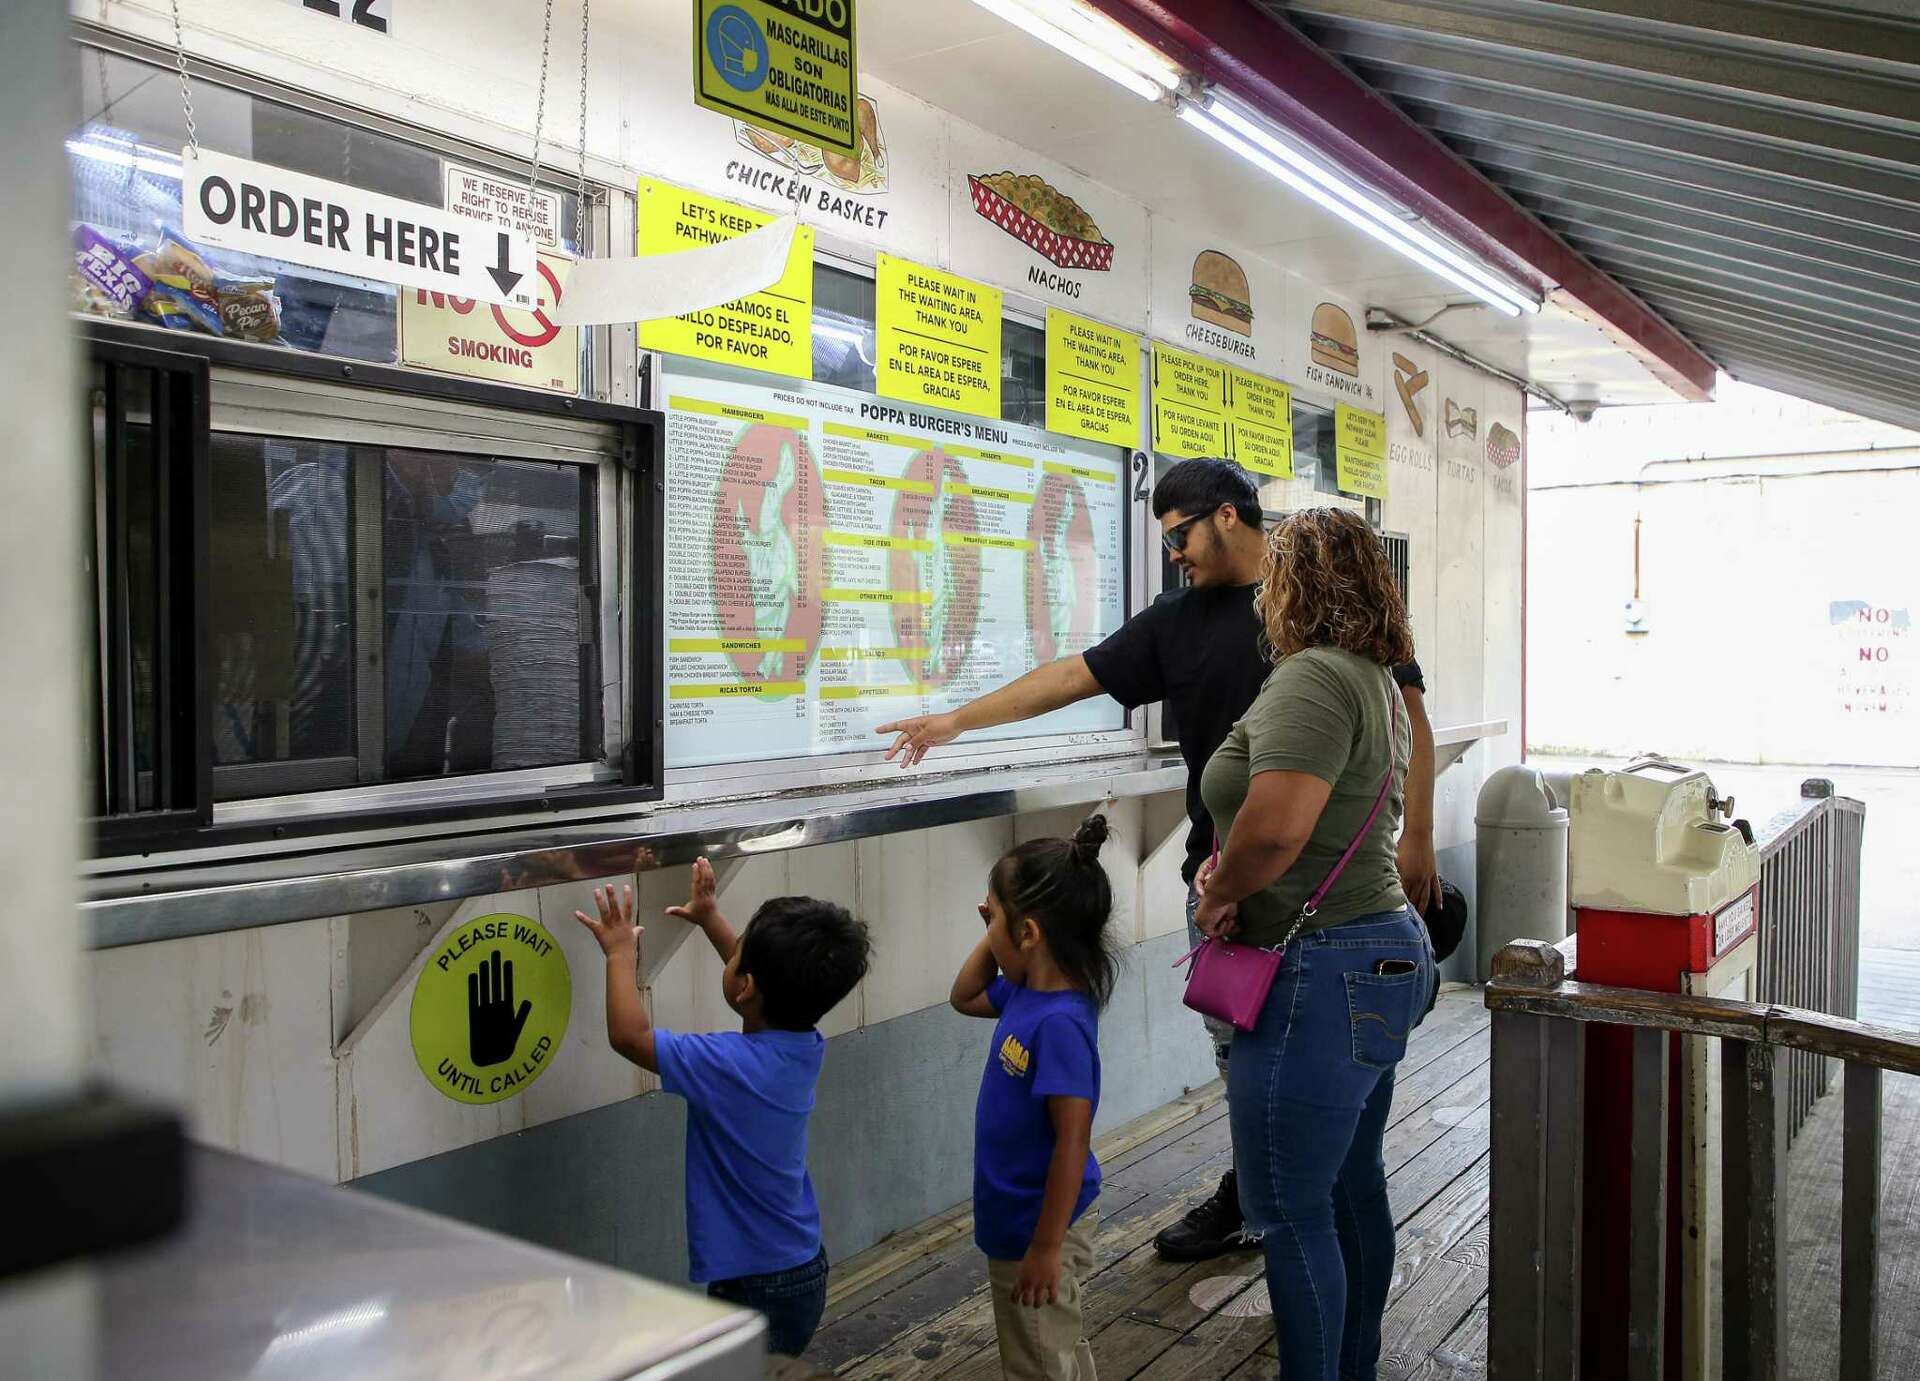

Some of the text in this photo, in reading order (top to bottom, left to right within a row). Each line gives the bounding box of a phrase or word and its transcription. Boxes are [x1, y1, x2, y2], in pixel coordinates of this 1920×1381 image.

[766, 18, 848, 69] MASCARILLAS
[794, 57, 823, 79] SON
[769, 67, 848, 112] OBLIGATORIAS
[800, 105, 808, 118] DE
[810, 108, 826, 125] ESTE
[828, 113, 849, 133] PUNTO
[463, 177, 548, 211] WE RESERVE THE
[726, 160, 888, 229] CHICKEN BASKET
[461, 192, 548, 225] RIGHT TO REFUSE
[682, 201, 752, 234] LET'S KEEP
[200, 175, 459, 276] ORDER HERE
[676, 221, 734, 245] PATHWA
[89, 243, 142, 292] BIG
[75, 251, 132, 312] TEXAS
[908, 274, 976, 303] PLEASE WAIT IN
[1028, 265, 1081, 298] NACHOS
[225, 302, 267, 318] Pecan
[776, 309, 790, 324] EL
[898, 288, 983, 324] THE WAITING AREA,
[236, 316, 260, 331] Pie
[718, 316, 795, 346] DESPEJADO,
[916, 310, 968, 334] THANK YOU
[696, 332, 768, 359] POR FAVOR
[1062, 337, 1076, 350] THE
[1077, 341, 1107, 359] WAITING
[1070, 325, 1121, 348] PLEASE WAIT IN
[1185, 324, 1256, 360] CHEESEBURGER
[448, 336, 533, 369] SMOKING
[899, 343, 982, 373] POR FAVOR ESPERE
[889, 358, 990, 392] EN EL AREA DE ESPERA,
[1076, 356, 1115, 376] THANK YOU
[1161, 353, 1219, 378] PLEASE PICK UP YOUR
[1174, 370, 1193, 385] ORDER
[1235, 376, 1284, 398] PLEASE PICK UP YOUR
[1306, 366, 1322, 384] FISH
[1325, 373, 1362, 397] SANDWICH
[773, 392, 854, 414] PRICES DO NOT INCLUDE TAX
[923, 383, 960, 400] GRACIAS
[1063, 385, 1126, 409] POR FAVOR ESPERE
[1176, 383, 1208, 400] THANK YOU
[1246, 392, 1262, 403] ORDER
[722, 408, 764, 421] HAMBURGERS
[1056, 398, 1066, 409] EN
[1067, 400, 1075, 411] EL
[1076, 403, 1095, 416] AREA
[1096, 407, 1106, 418] DE
[1248, 404, 1275, 419] THANK YOU
[860, 403, 1008, 444] POPPA BURGER'S MENU
[1080, 418, 1109, 433] GRACIAS
[1163, 409, 1220, 431] POR FAVOR LEVANTE
[866, 431, 889, 442] BASKETS
[1171, 424, 1178, 434] SU
[1179, 426, 1199, 440] ORDEN
[1239, 428, 1284, 447] POR FAVOR LEVANTE
[1182, 440, 1206, 453] GRACIAS
[1252, 443, 1268, 454] ORDEN
[1390, 443, 1432, 472] EGG ROLLS
[1254, 455, 1274, 467] GRACIAS
[1447, 460, 1475, 483] TORTAS
[869, 477, 886, 486] TACOS
[1133, 451, 1151, 502] 2
[1859, 608, 1889, 623] NO
[1859, 647, 1889, 662] NO
[720, 686, 762, 694] RICAS TORTAS
[436, 922, 553, 972] PLEASE WAIT
[437, 1035, 552, 1095] UNTIL CALLED
